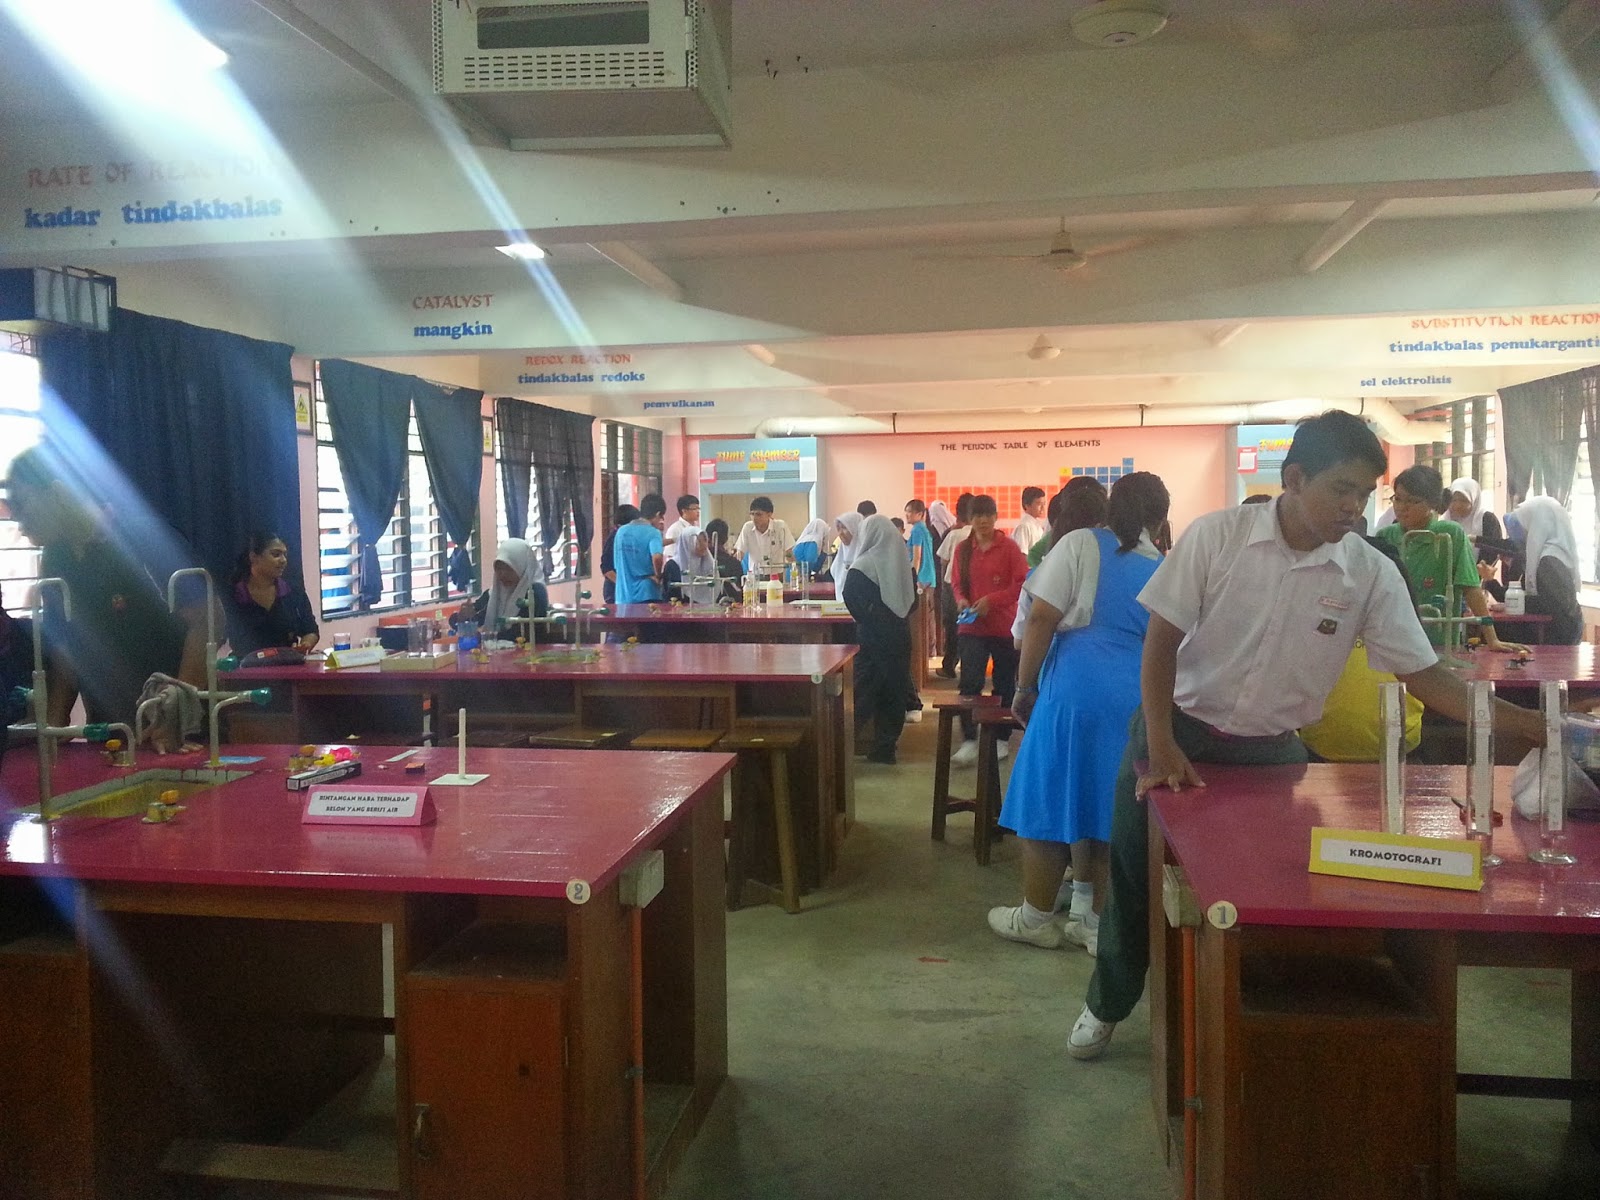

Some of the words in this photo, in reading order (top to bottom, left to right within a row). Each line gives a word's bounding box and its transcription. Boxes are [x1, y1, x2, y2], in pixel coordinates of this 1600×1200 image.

[27, 164, 92, 188] RATE
[104, 161, 132, 183] OF
[24, 206, 100, 229] kadar
[121, 198, 282, 225] tindakbalas
[413, 294, 493, 310] CATALYST
[414, 321, 493, 340] mangkin
[1389, 341, 1484, 352] tindakbalas
[526, 355, 564, 366] REDOX
[571, 353, 631, 366] REACTION
[518, 371, 594, 384] tindakbalas
[601, 371, 645, 383] redoks
[1360, 378, 1376, 387] sel
[1382, 375, 1452, 386] elektrolisis
[940, 443, 957, 451] THE
[1004, 441, 1029, 450] TABLE
[1036, 441, 1048, 449] OF
[1054, 439, 1101, 449] ELEMENTS
[1349, 848, 1442, 866] KROMOTOGRAFI
[573, 882, 584, 900] 2
[1216, 905, 1228, 925] 1
